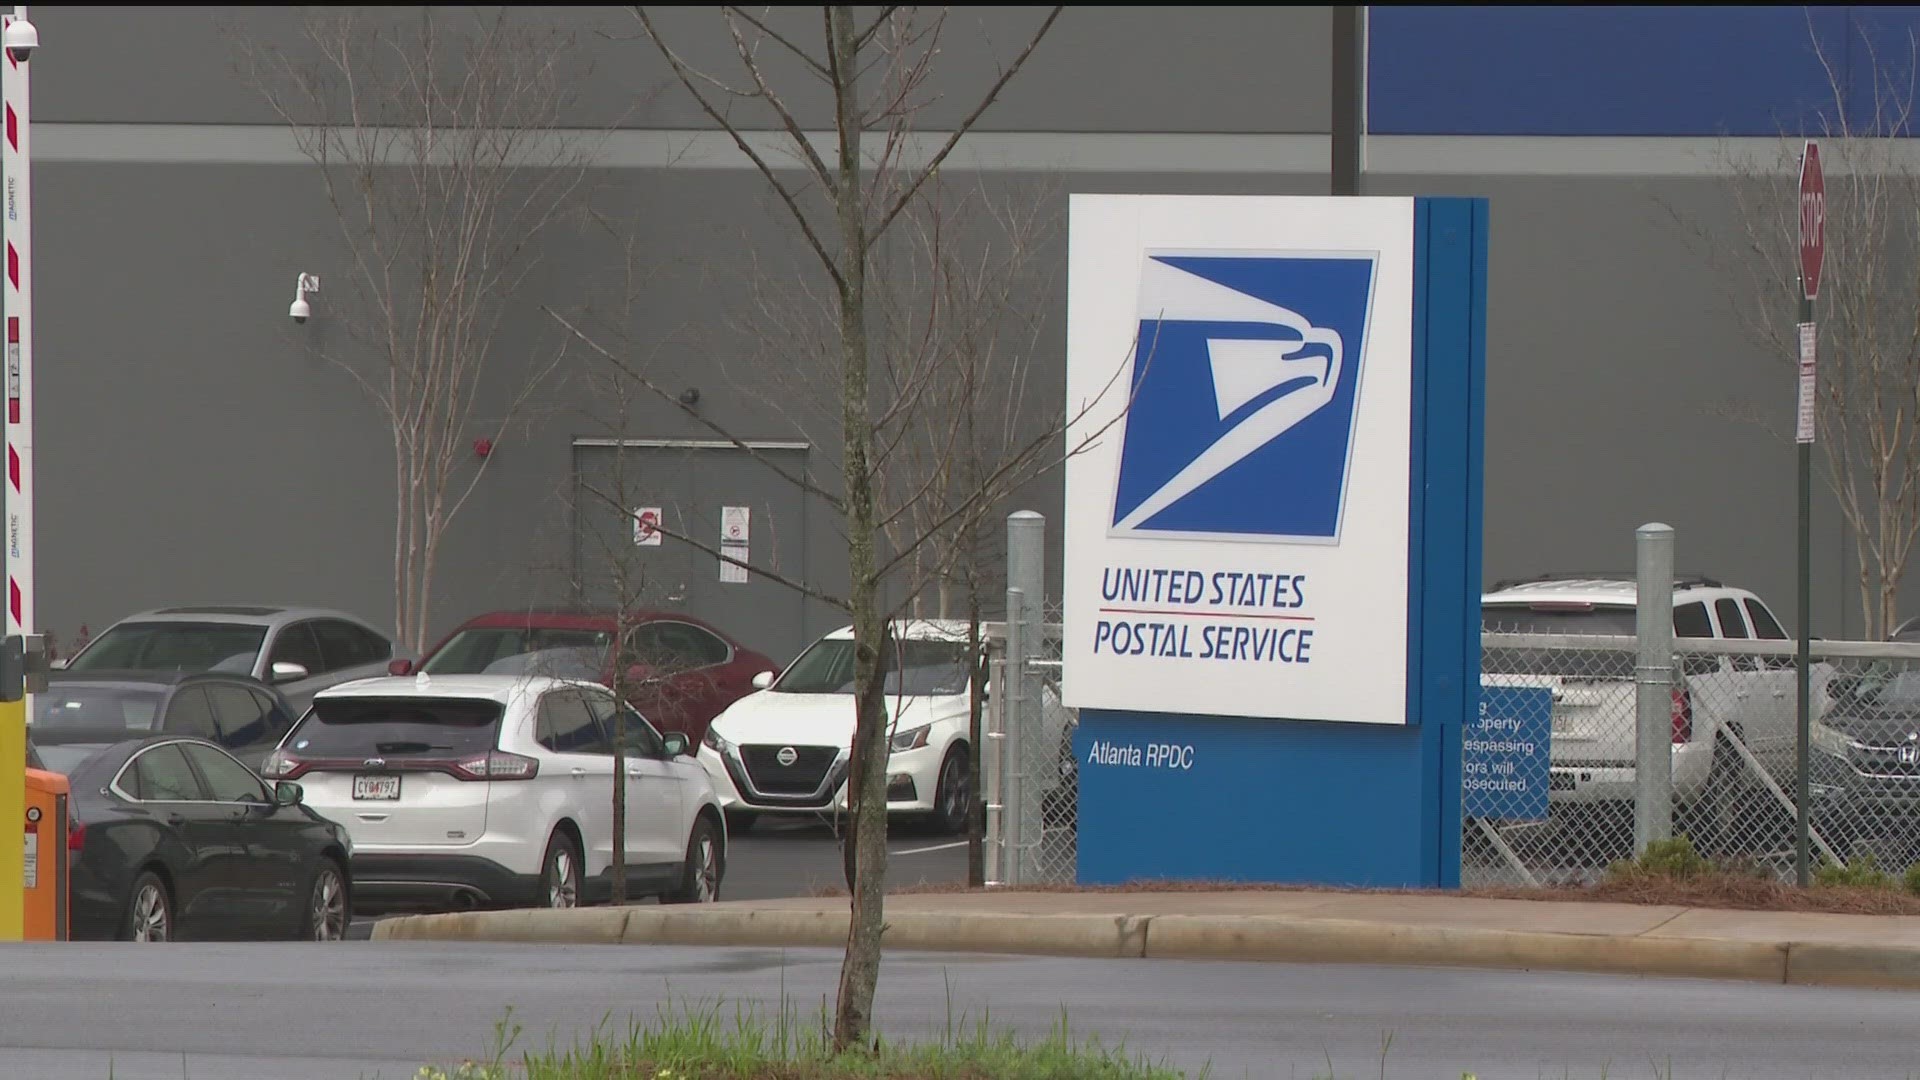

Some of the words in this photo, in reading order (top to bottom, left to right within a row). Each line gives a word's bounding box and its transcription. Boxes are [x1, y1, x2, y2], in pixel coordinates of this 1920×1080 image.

[1801, 192, 1823, 248] STOP
[1101, 567, 1205, 604] UNITED
[1209, 571, 1306, 609] STATES
[1093, 620, 1193, 658] POSTAL
[1199, 625, 1314, 664] SERVICE
[1471, 717, 1522, 734] operty
[1087, 740, 1142, 767] Atlanta
[1145, 743, 1195, 770] RPDC
[1463, 740, 1535, 756] espassing
[1491, 761, 1515, 775] will
[1463, 778, 1527, 792] osecuted
